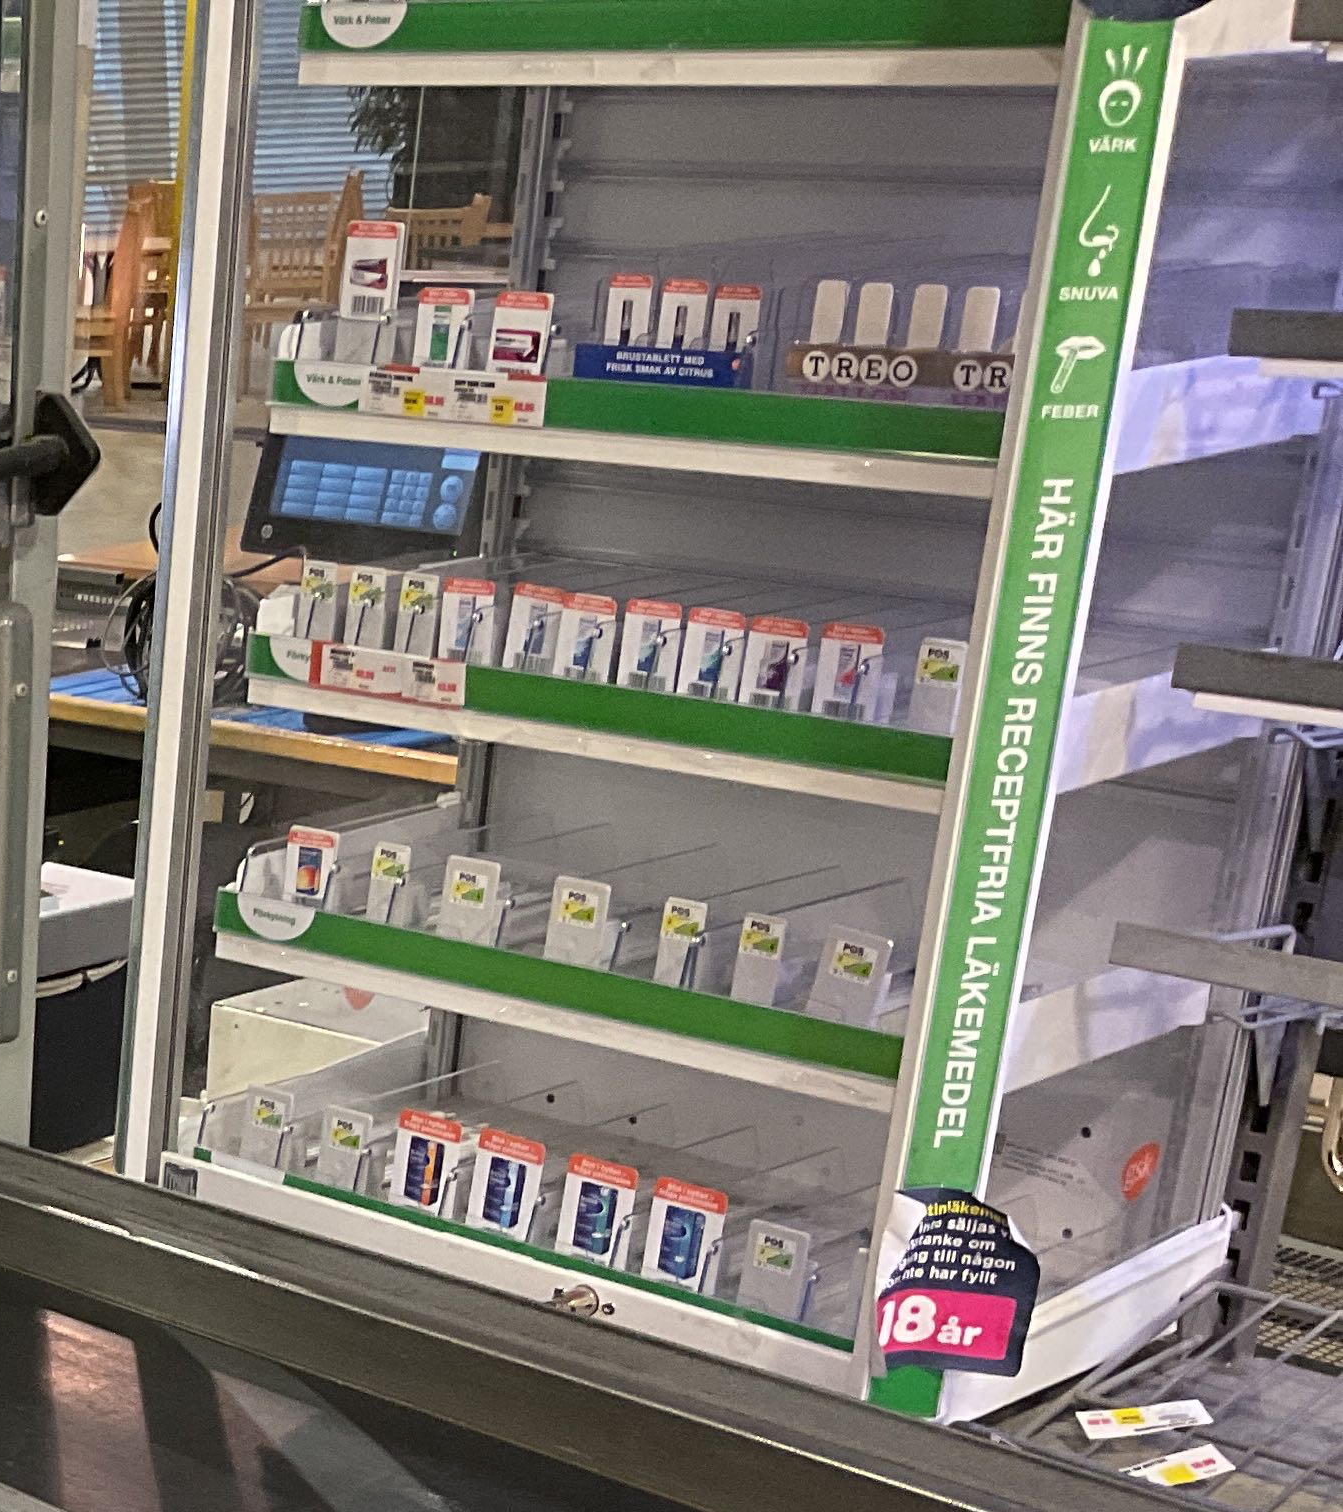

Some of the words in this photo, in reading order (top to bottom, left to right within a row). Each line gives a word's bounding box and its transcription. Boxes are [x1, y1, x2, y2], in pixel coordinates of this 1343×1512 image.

[1089, 134, 1137, 153] VÄRK
[1058, 286, 1119, 301] SNUVA
[684, 355, 705, 366] MED
[809, 356, 914, 382] TREO
[1041, 404, 1099, 419] FEBER
[1031, 478, 1076, 561] HÄR
[1012, 572, 1058, 686] FINNS
[971, 697, 1038, 926] RECEPTFRIA
[933, 936, 1001, 1149] LÄKEMEDEL
[947, 1217, 995, 1235] säljas
[764, 1235, 784, 1250] POS
[968, 1237, 996, 1252] om
[933, 1249, 956, 1264] till
[961, 1252, 1017, 1272] någon
[929, 1265, 958, 1281] har
[961, 1267, 998, 1286] fyllt
[878, 1294, 937, 1347] 18
[937, 1315, 983, 1347] år
